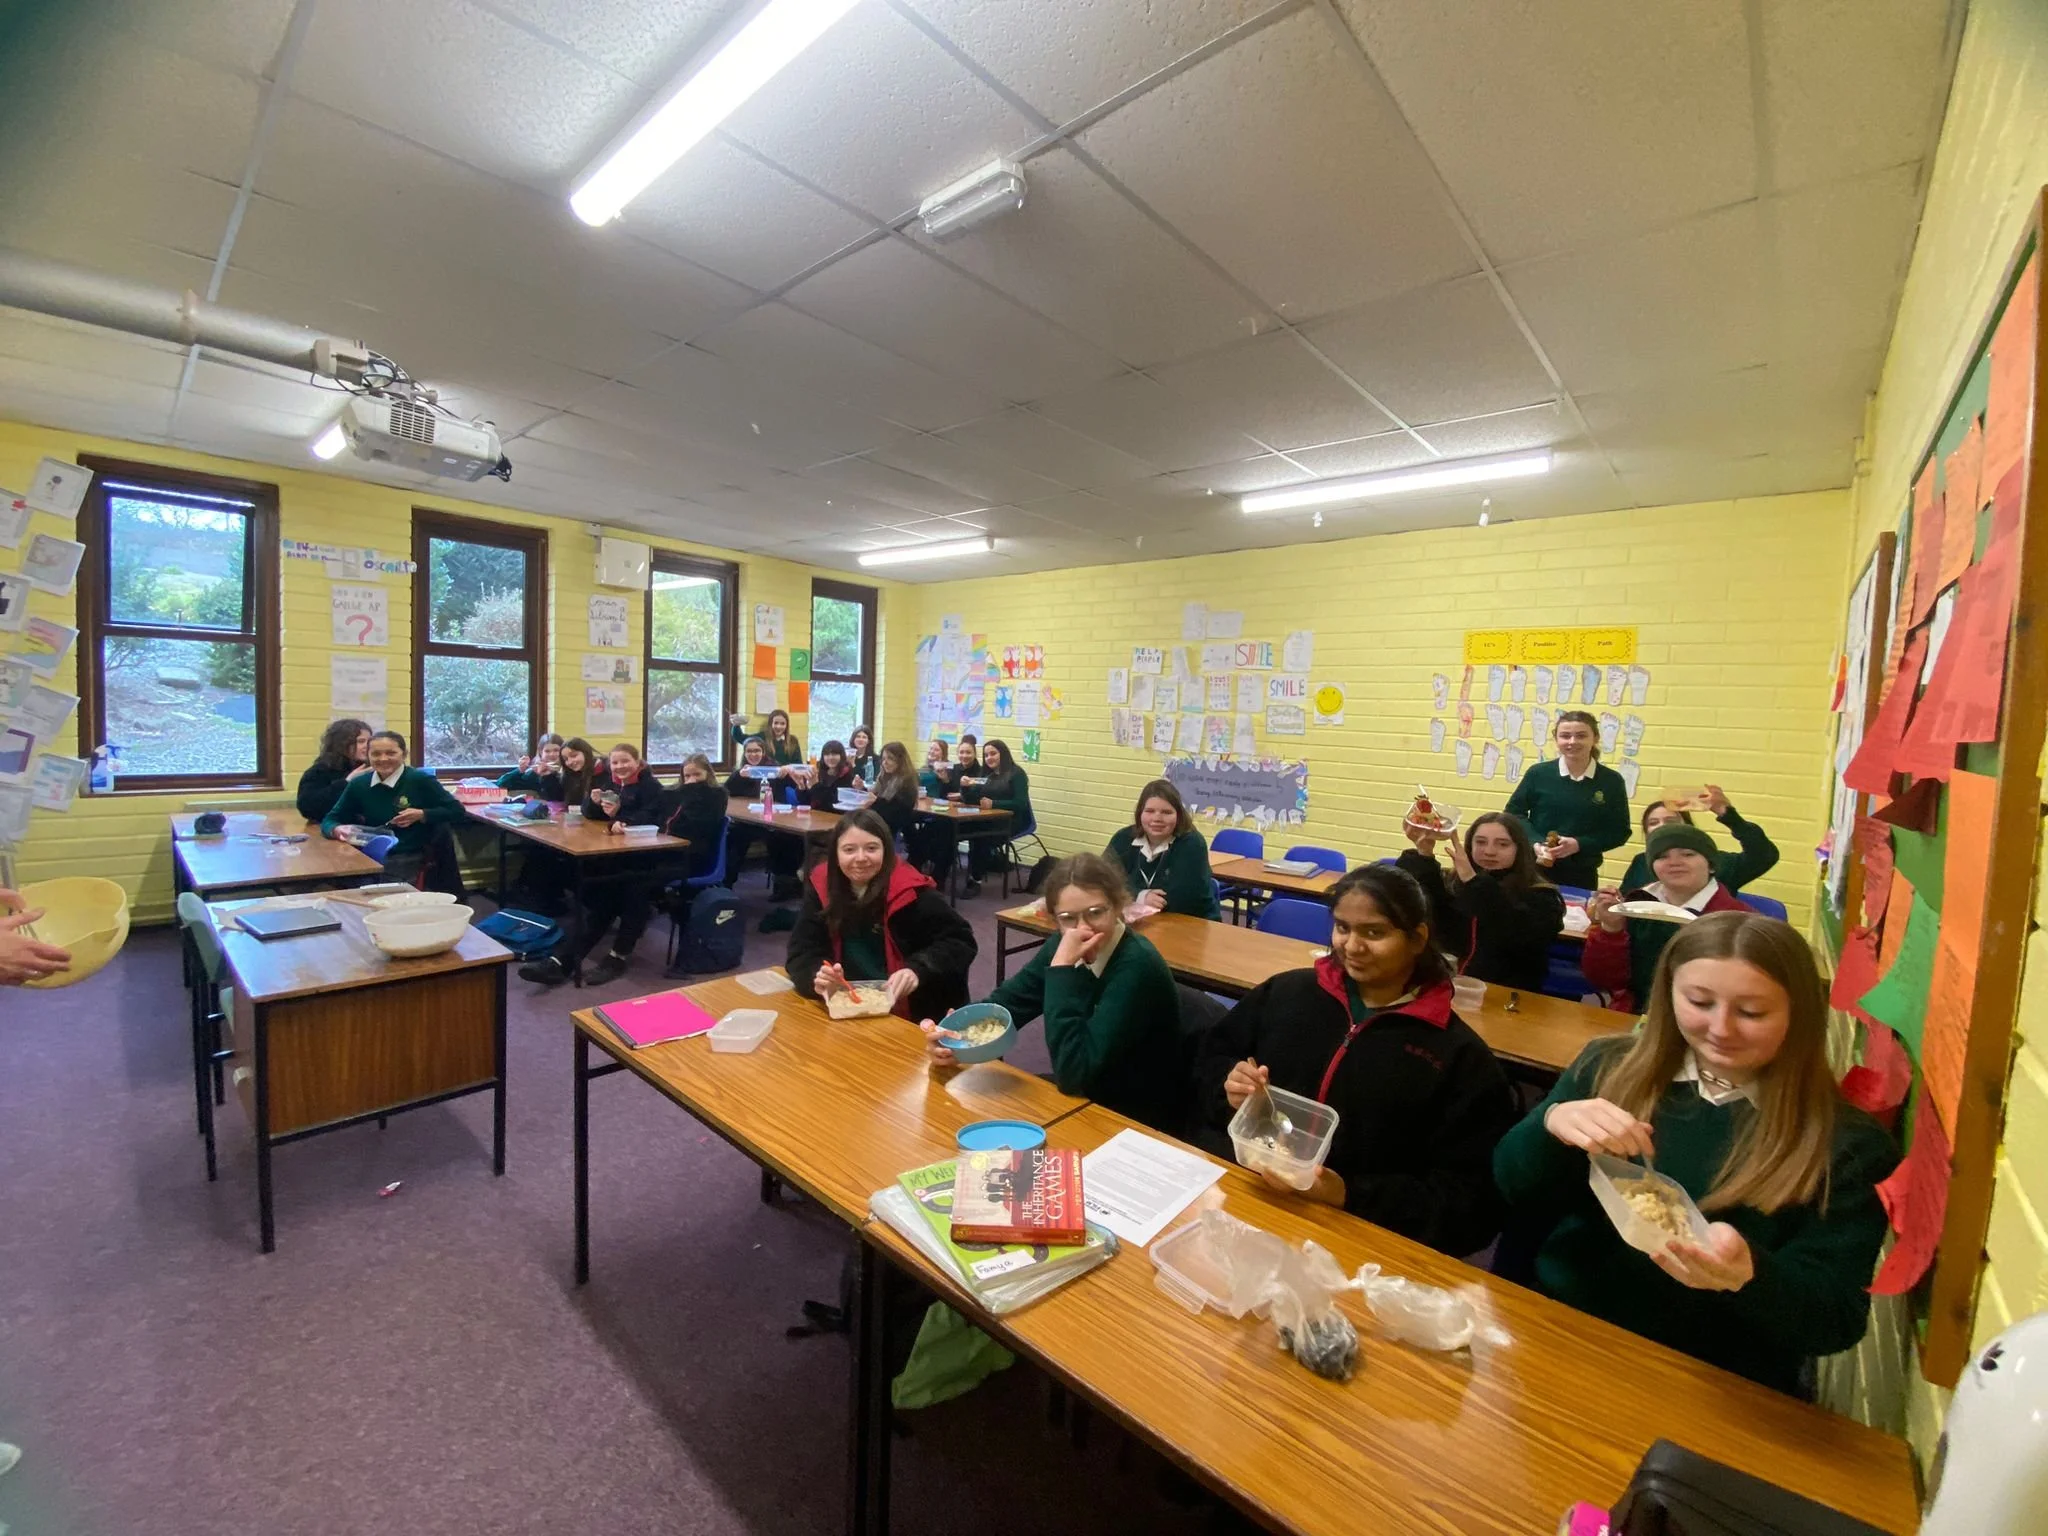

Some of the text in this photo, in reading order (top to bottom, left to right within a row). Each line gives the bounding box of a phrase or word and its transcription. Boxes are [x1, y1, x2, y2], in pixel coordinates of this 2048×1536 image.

[1270, 679, 1305, 696] SMILE
[1032, 1149, 1045, 1225] INHERITANCE
[1044, 1155, 1067, 1220] GAMES
[1022, 1201, 1033, 1220] THE
